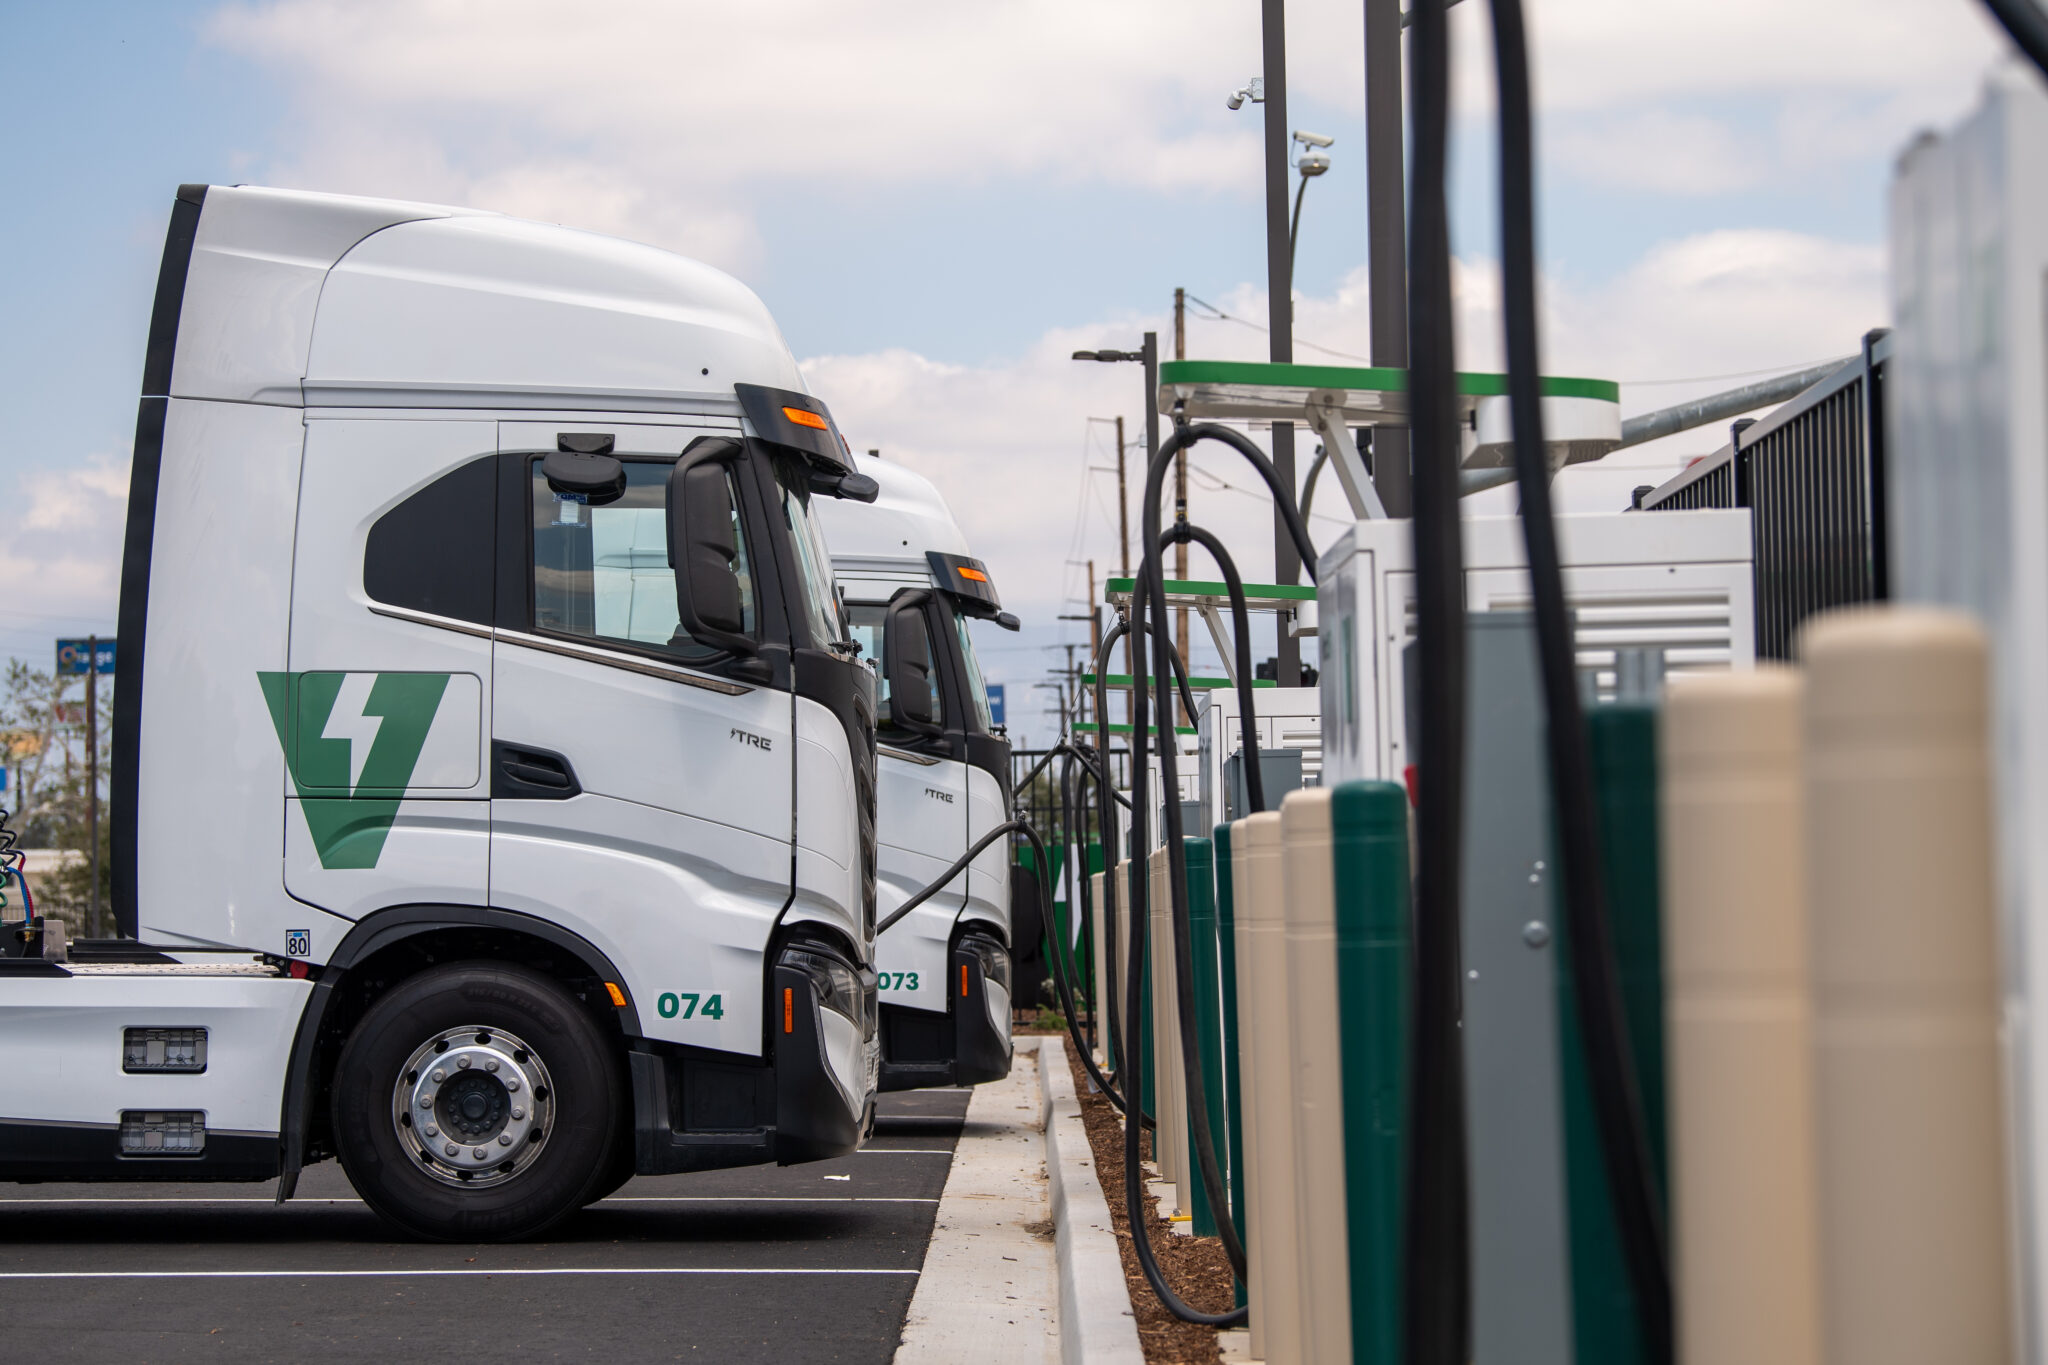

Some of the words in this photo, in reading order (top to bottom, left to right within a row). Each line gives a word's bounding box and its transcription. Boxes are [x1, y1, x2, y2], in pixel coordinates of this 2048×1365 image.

[289, 937, 307, 955] 80
[878, 972, 919, 991] 073
[657, 992, 724, 1020] 074
